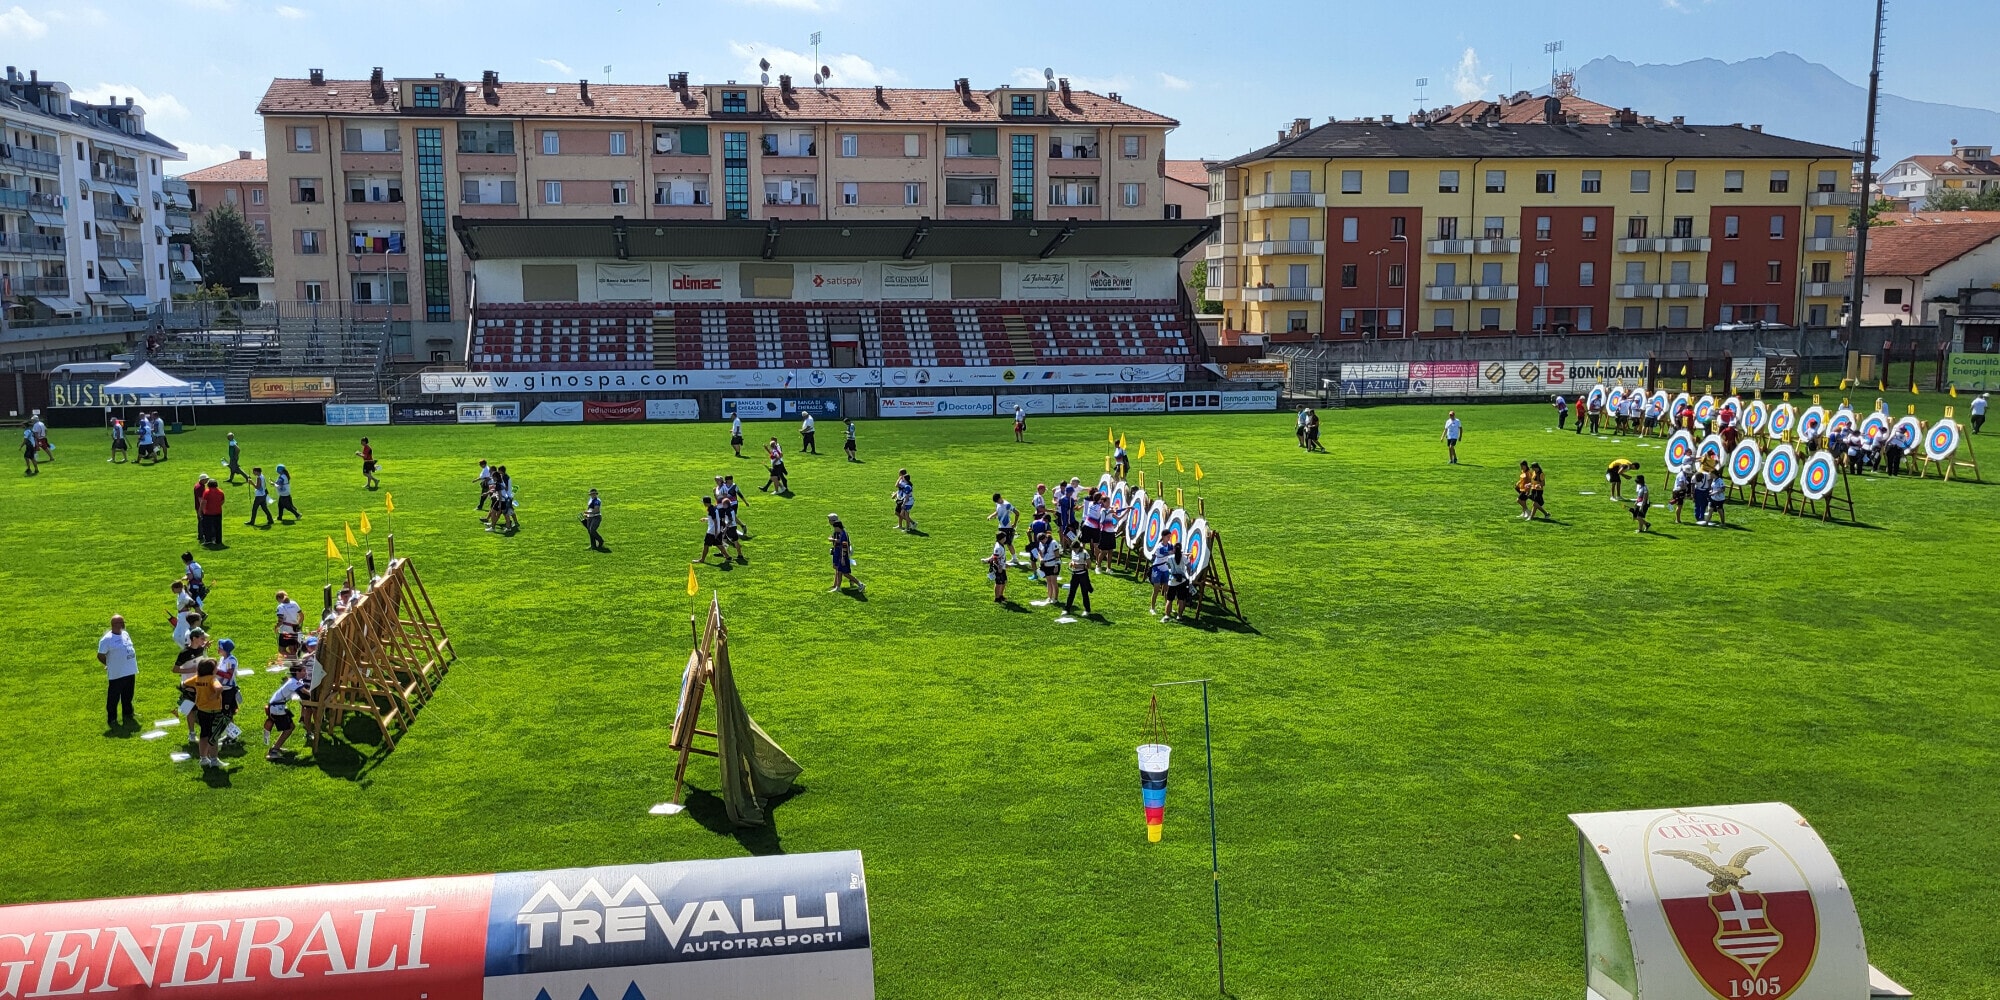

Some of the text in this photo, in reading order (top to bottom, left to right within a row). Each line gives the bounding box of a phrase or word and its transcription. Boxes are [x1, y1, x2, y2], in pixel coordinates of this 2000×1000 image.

[672, 274, 722, 290] olimac
[826, 275, 862, 287] satispay
[895, 275, 929, 283] GENERALI
[1367, 364, 1406, 372] AZIMUT
[1953, 356, 1999, 366] Comunità
[1952, 368, 1987, 377] Energie
[451, 373, 689, 390] www.ginospa.com
[1366, 381, 1406, 389] AZIMUT
[948, 402, 992, 411] DoctorApp
[1658, 822, 1740, 840] CUNEO
[849, 872, 861, 890] Play
[516, 891, 841, 950] TREVALLI
[681, 931, 843, 954] AUTOTRASPORTI
[0, 904, 437, 999] GENERALI
[1728, 975, 1781, 998] 1905
